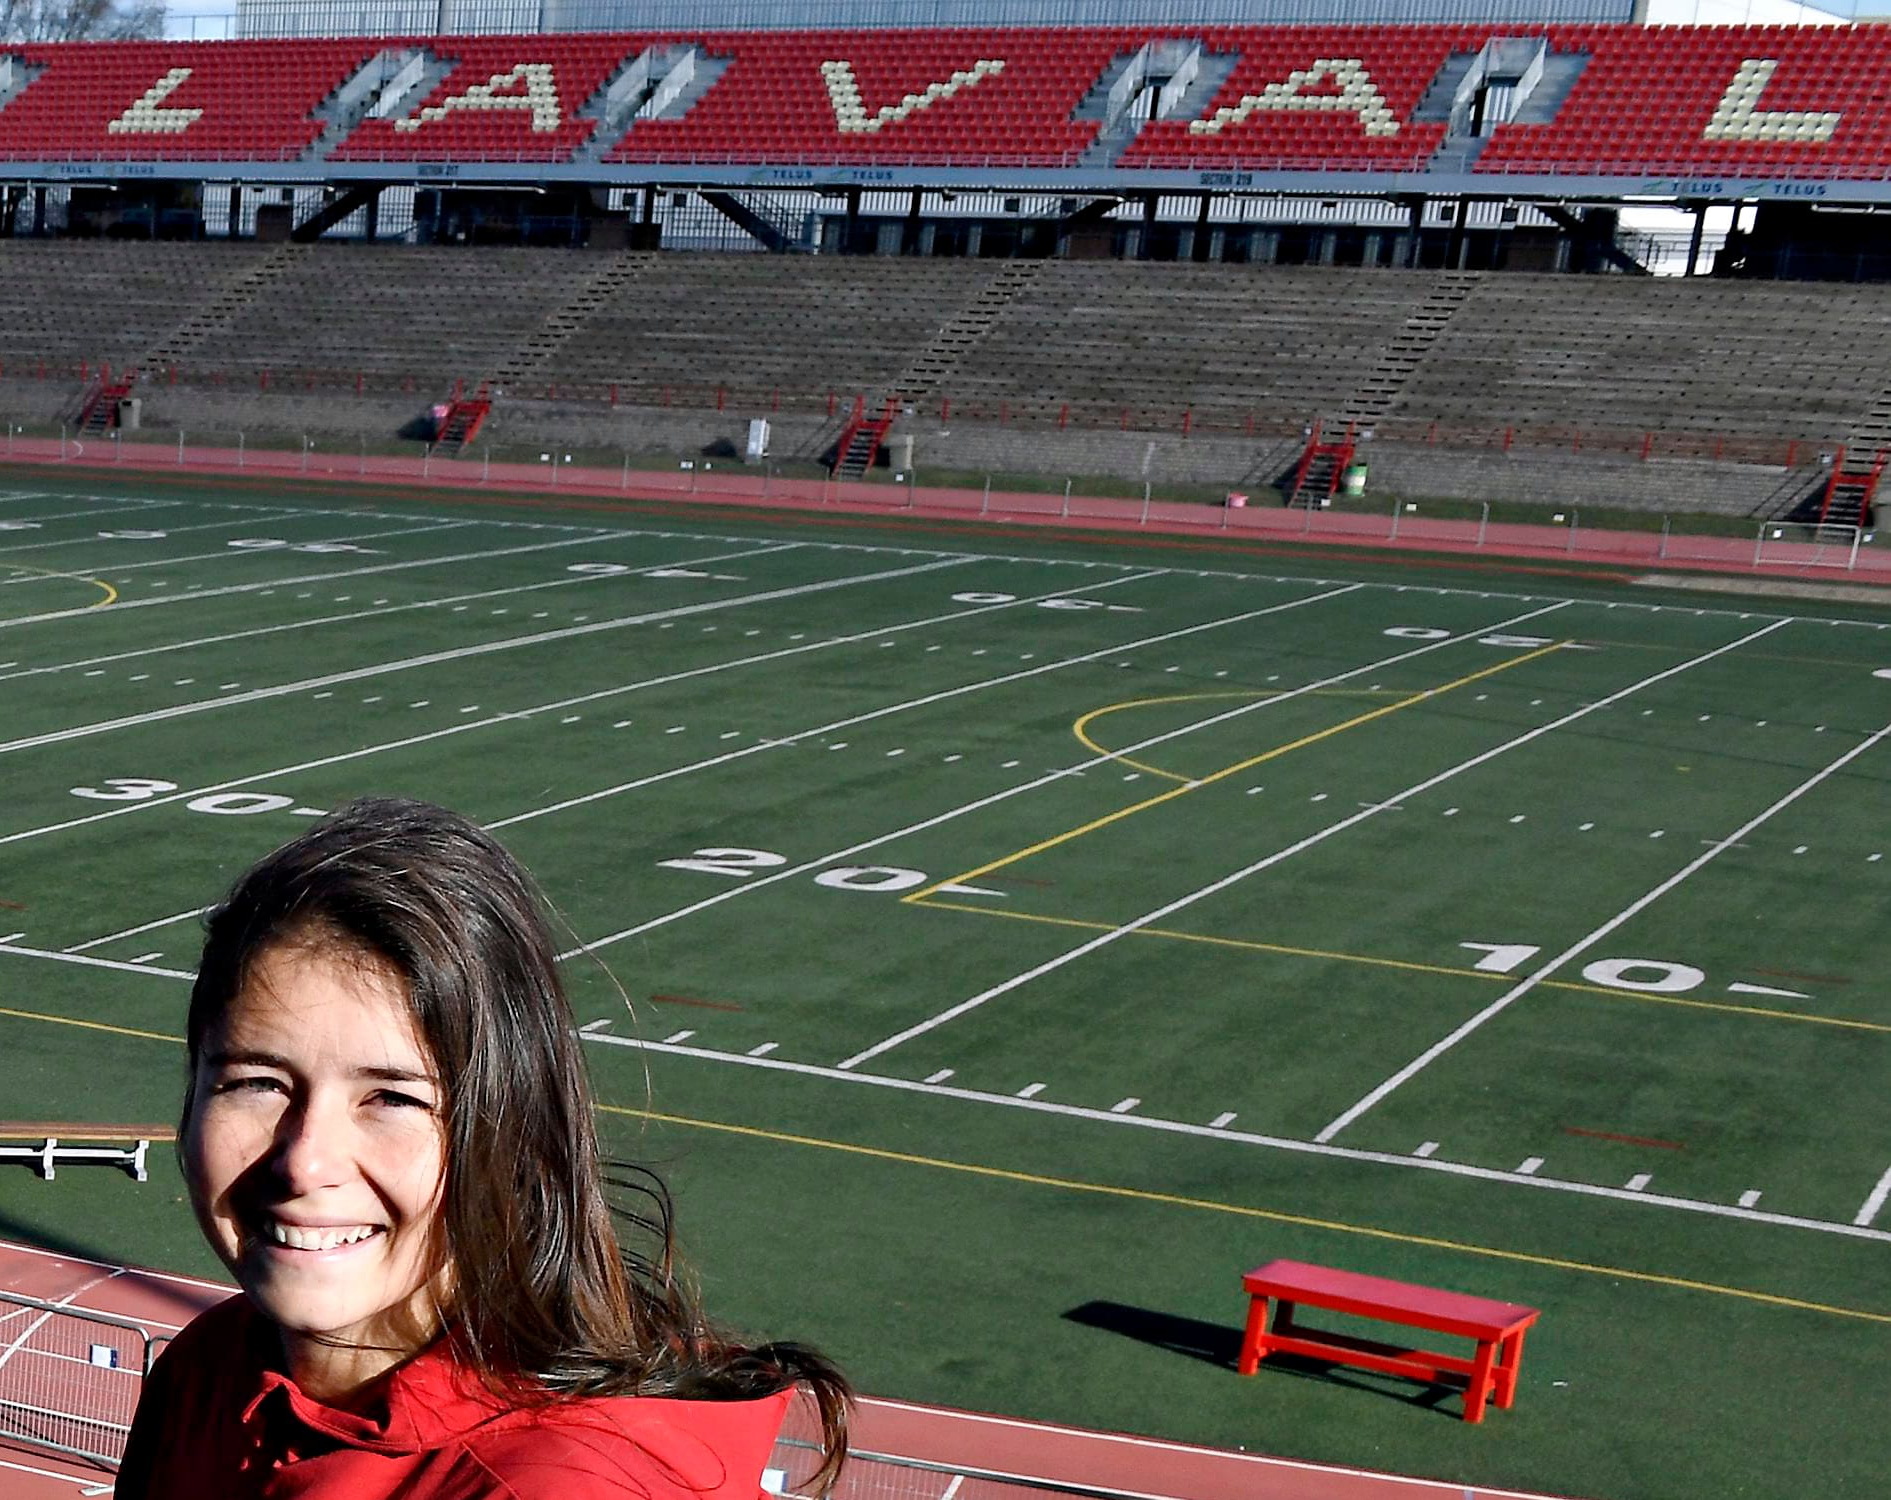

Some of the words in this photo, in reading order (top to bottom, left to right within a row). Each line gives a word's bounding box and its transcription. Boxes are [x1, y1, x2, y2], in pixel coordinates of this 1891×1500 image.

[772, 169, 813, 179] TELUS
[852, 170, 894, 180] TELUS
[1671, 181, 1724, 193] TELUS
[1773, 183, 1828, 196] TELUS
[655, 846, 929, 893] 20
[1457, 940, 1707, 993] 10
